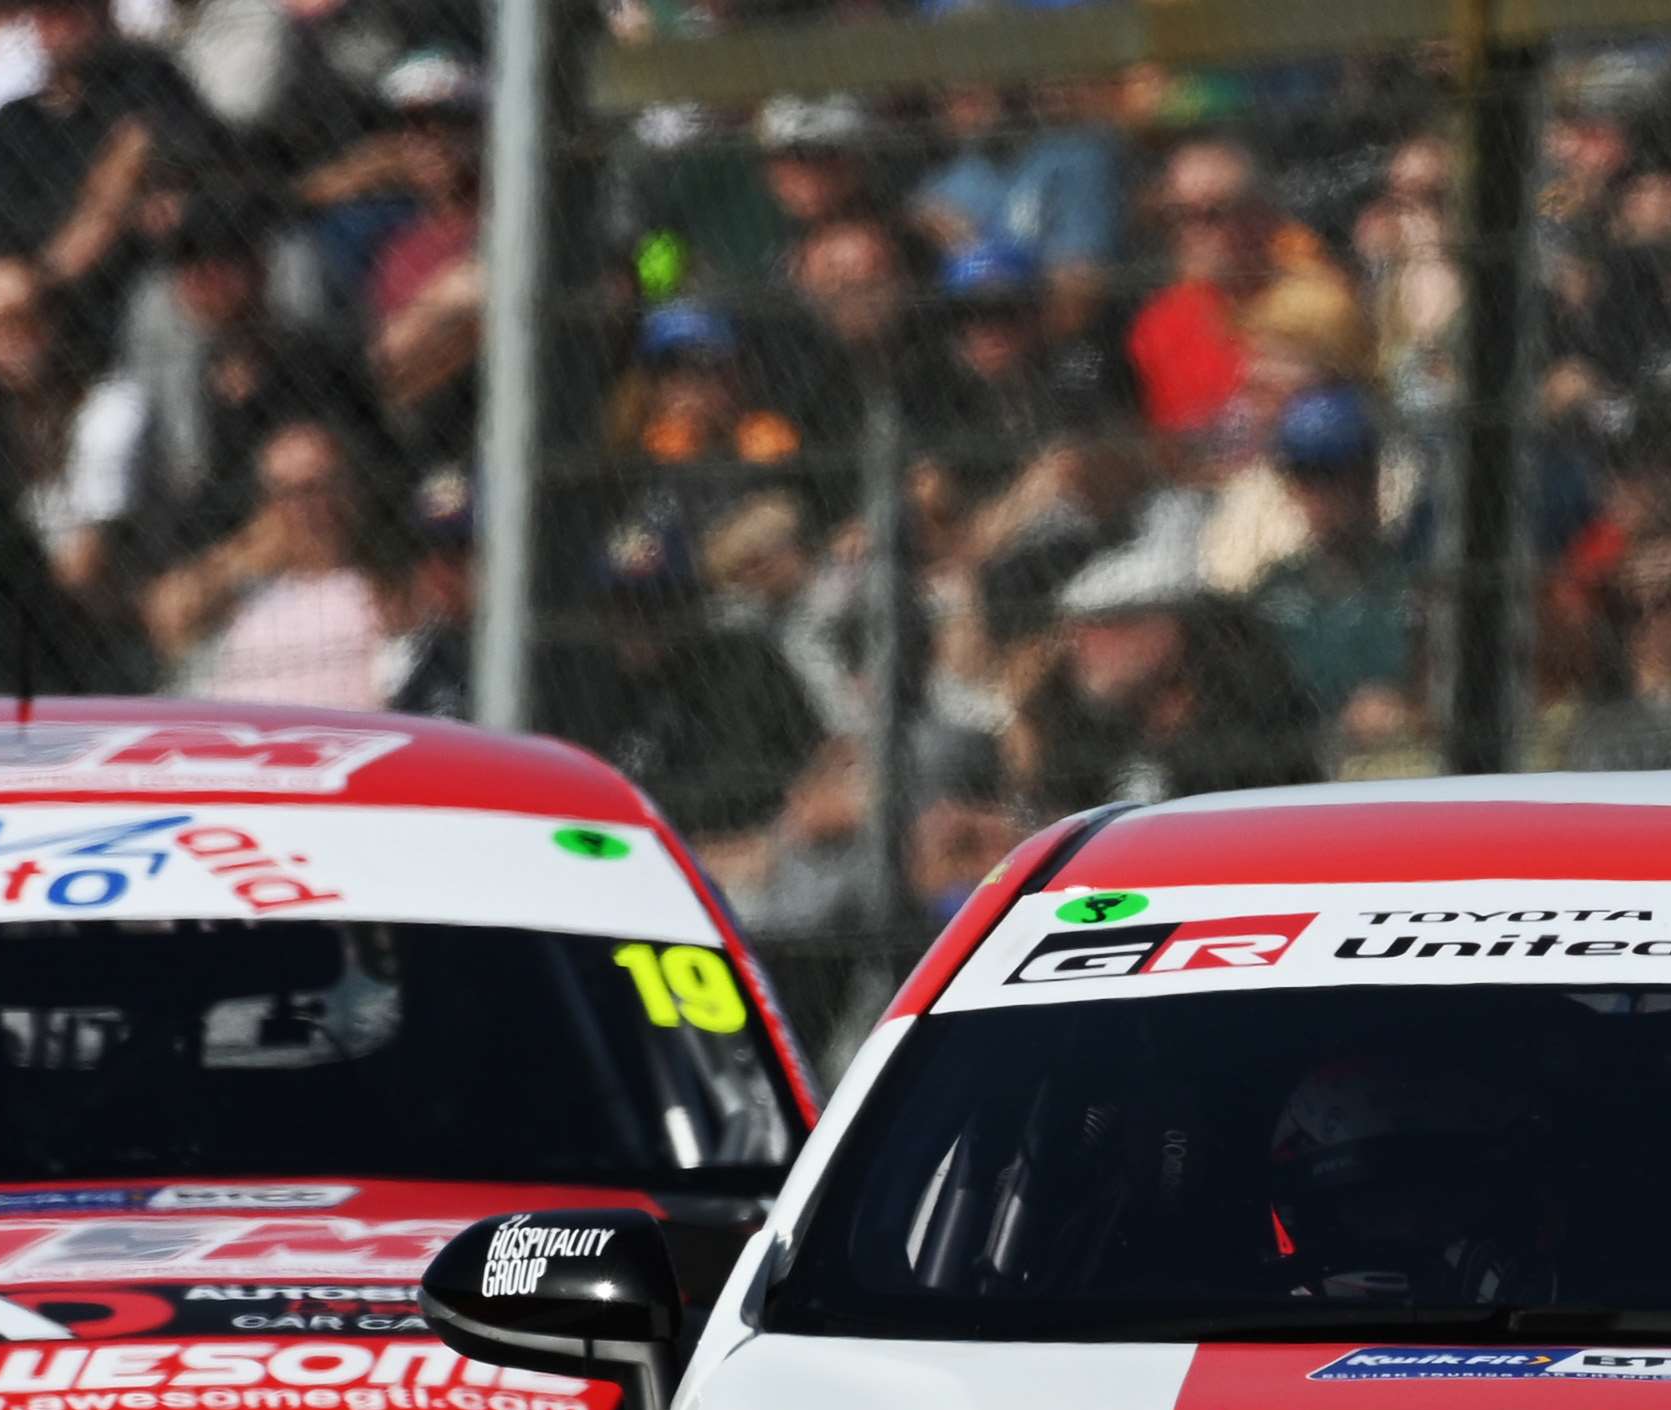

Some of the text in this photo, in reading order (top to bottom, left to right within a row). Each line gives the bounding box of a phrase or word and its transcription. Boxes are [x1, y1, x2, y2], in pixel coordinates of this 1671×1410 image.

[173, 822, 345, 915] aid
[1360, 910, 1653, 926] TOYOTA
[1018, 933, 1288, 982] GR
[613, 942, 746, 1033] 19
[487, 1227, 616, 1261] HOSPITALITY
[482, 1257, 547, 1298] GROUP
[231, 1313, 328, 1330] CAR
